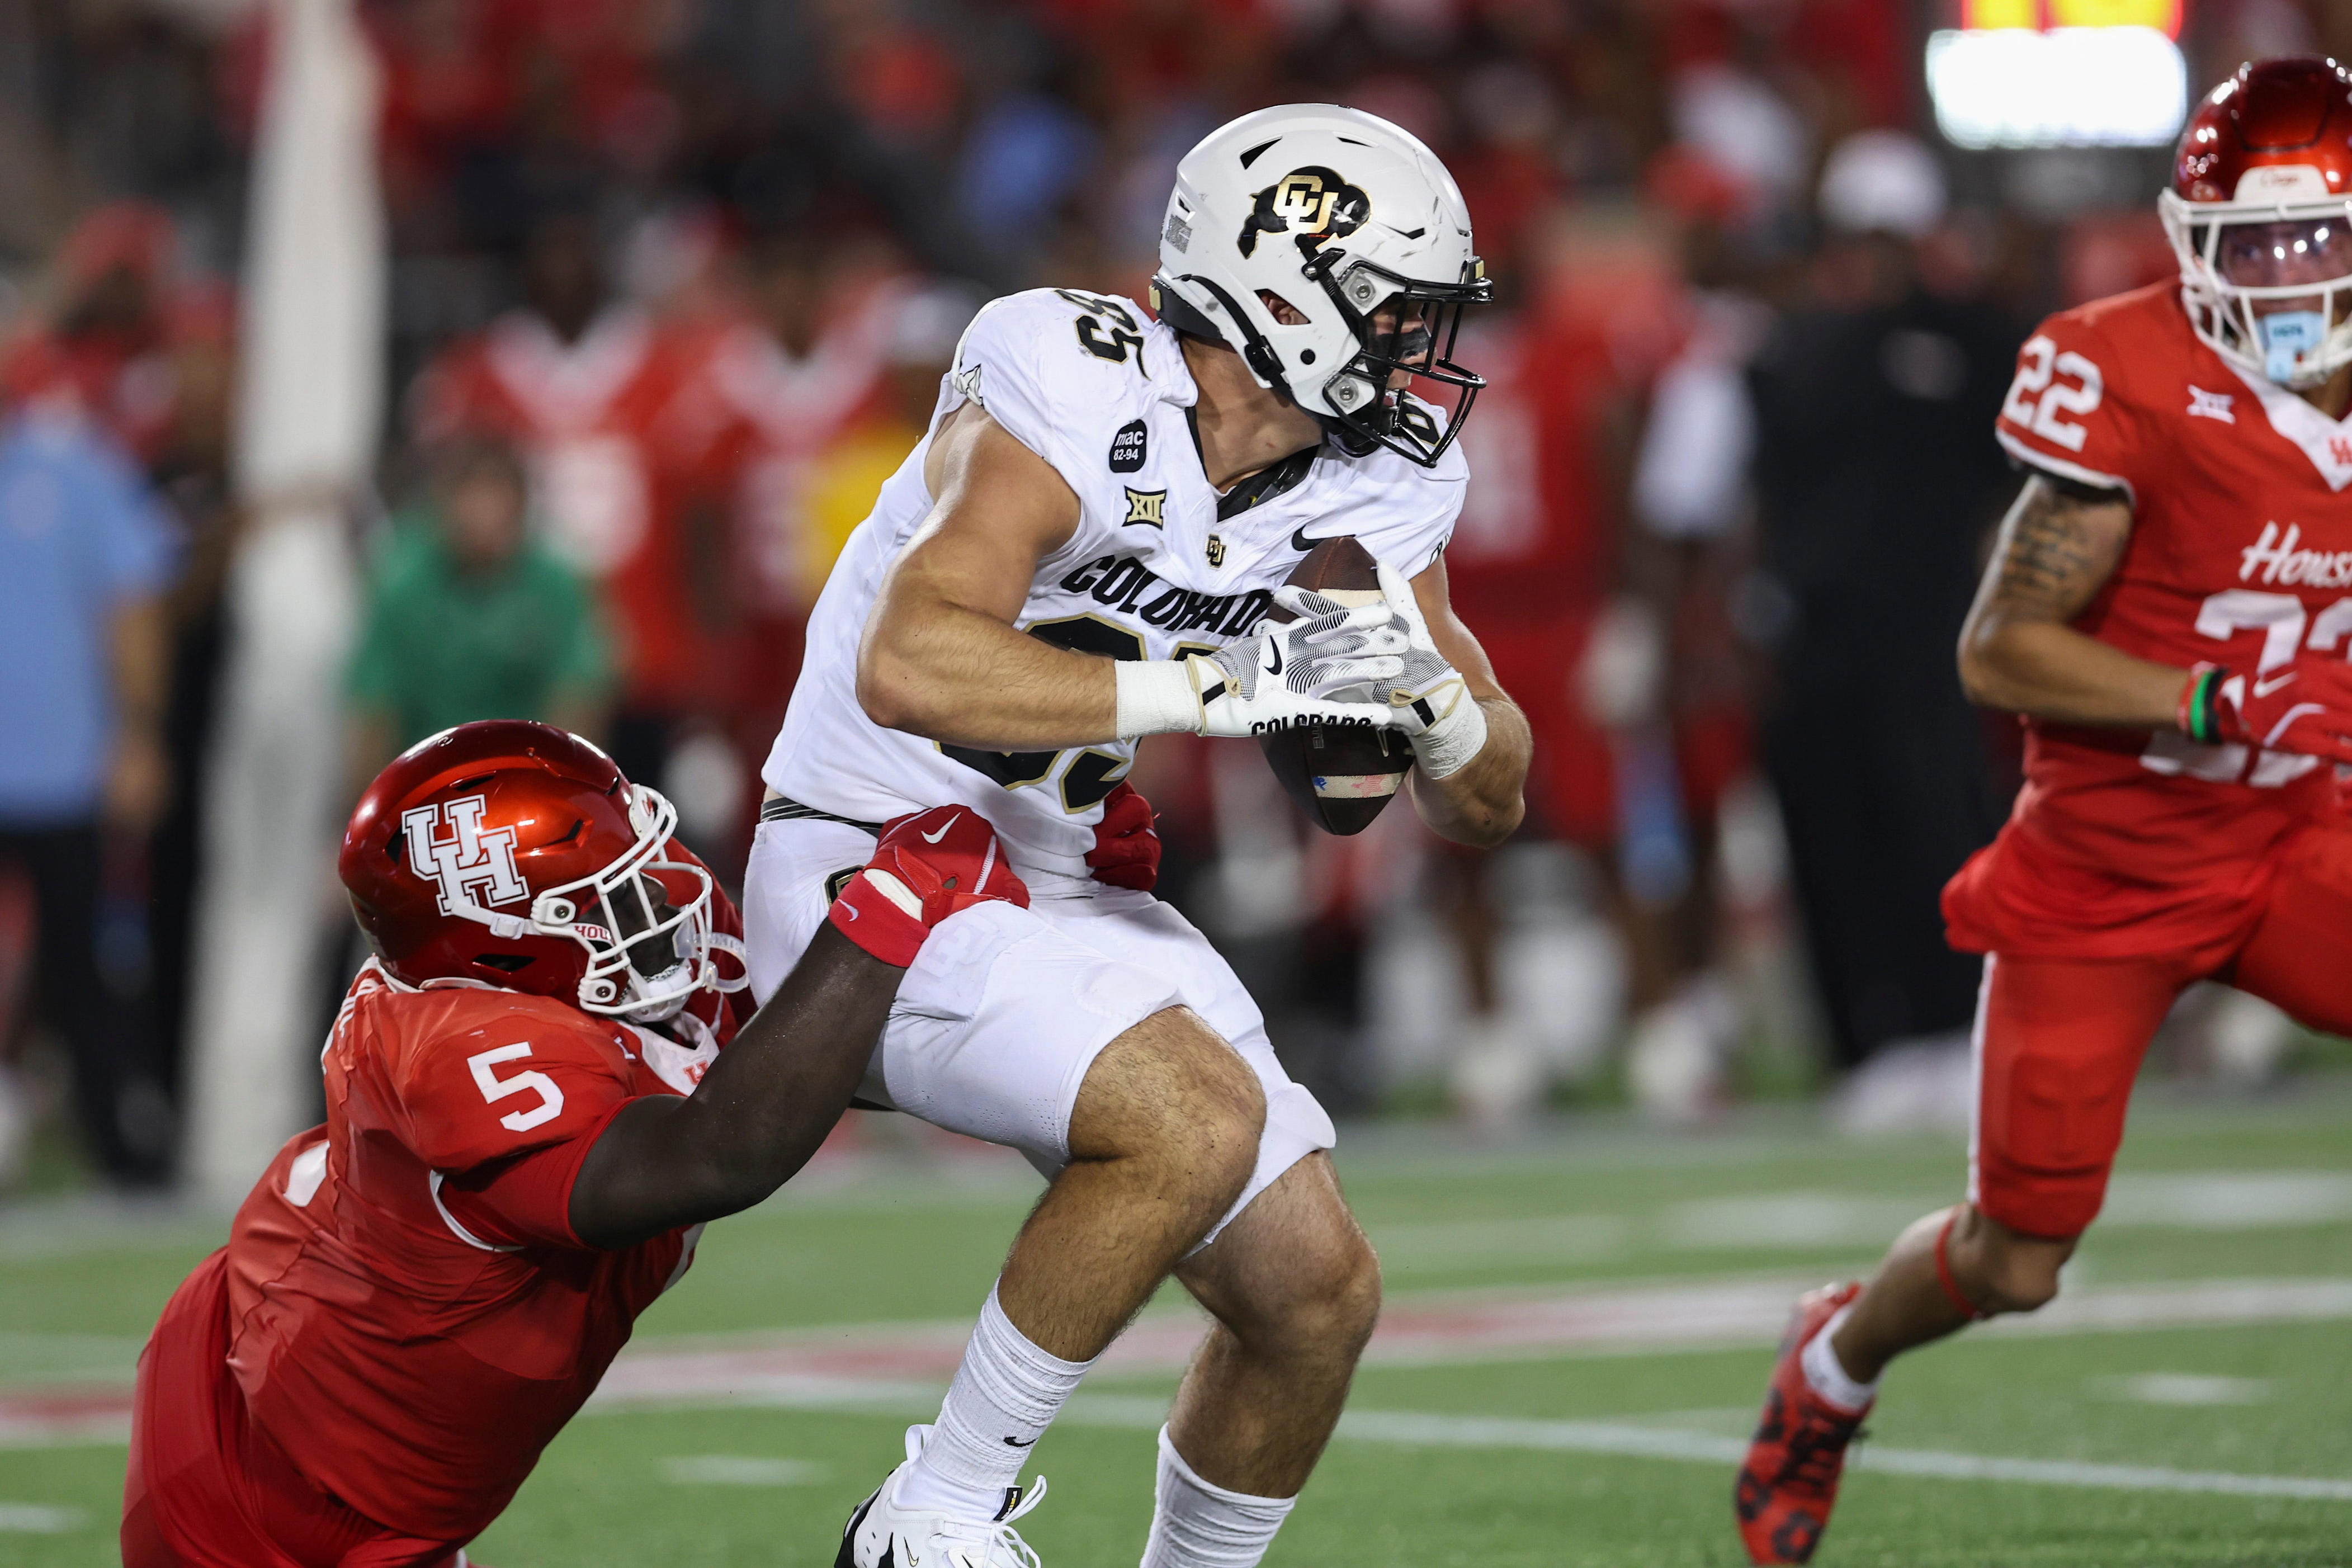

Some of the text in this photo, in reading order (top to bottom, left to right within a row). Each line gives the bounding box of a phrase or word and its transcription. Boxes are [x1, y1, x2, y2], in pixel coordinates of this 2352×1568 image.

[1272, 175, 1339, 233] CU
[2003, 336, 2103, 453] 22
[1113, 448, 1139, 461] 82-94
[1114, 431, 1144, 447] mac
[1122, 484, 1167, 531] XII
[2239, 520, 2352, 587] Hous
[1059, 554, 1273, 637] COLORAD
[402, 794, 530, 917] UH
[466, 1041, 564, 1132] 5
